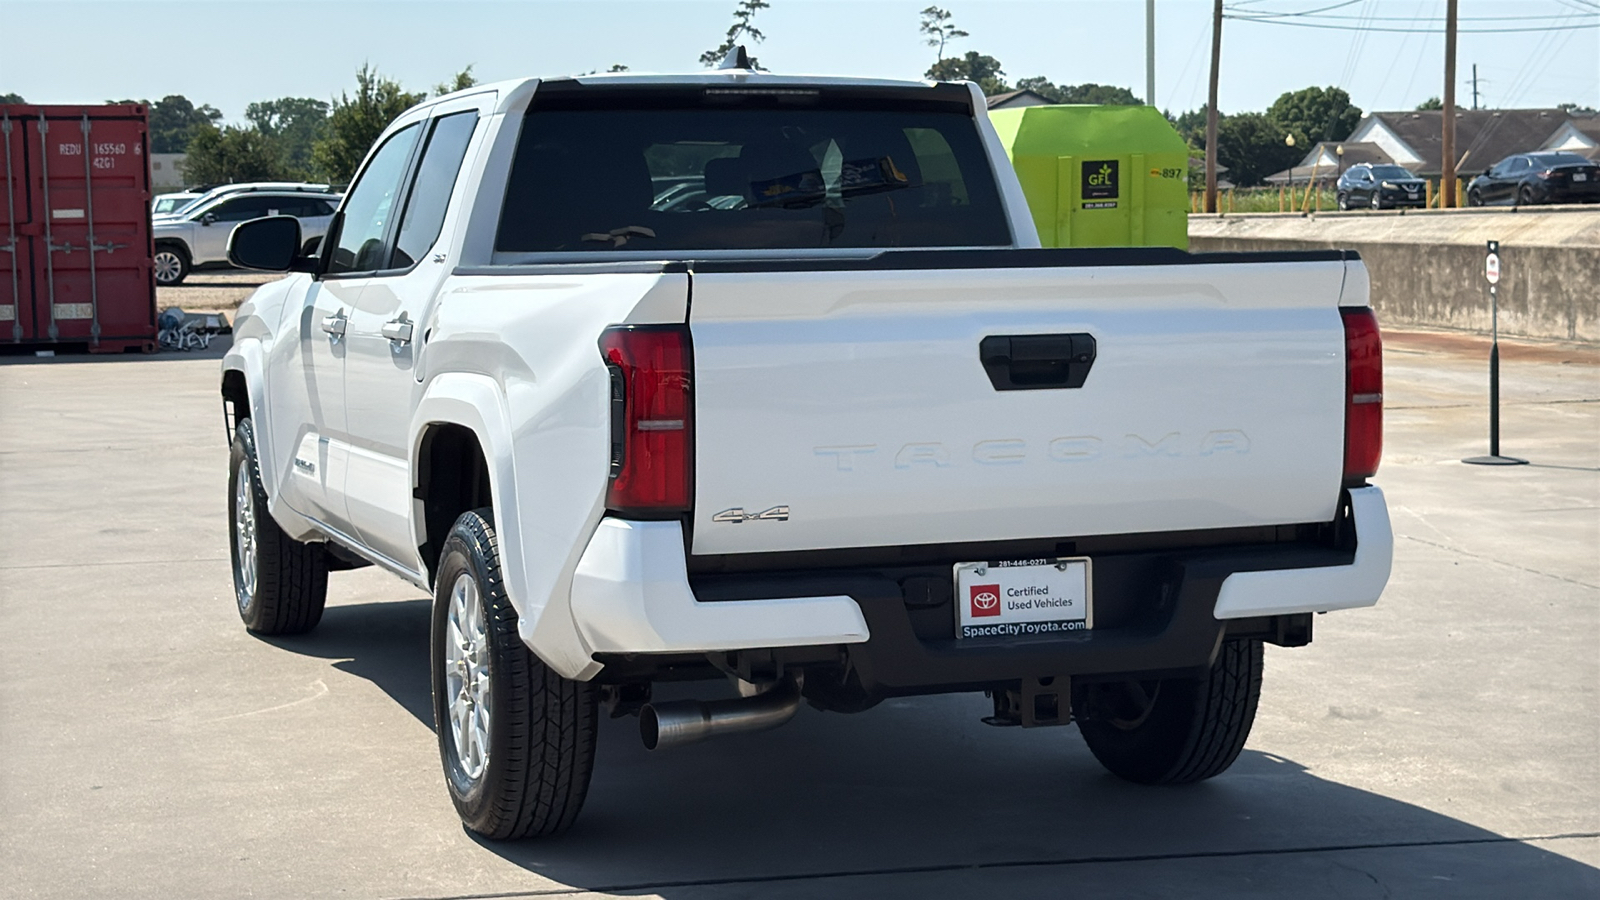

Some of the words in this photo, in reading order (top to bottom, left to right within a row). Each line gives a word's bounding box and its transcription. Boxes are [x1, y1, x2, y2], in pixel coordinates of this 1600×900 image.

[59, 143, 82, 155] REDU
[94, 143, 126, 155] 165560
[134, 143, 141, 155] 6
[93, 157, 115, 169] 42G1
[1088, 168, 1112, 186] GFL
[813, 428, 1252, 472] TACOMA
[998, 559, 1047, 567] 281-446-0271
[1007, 585, 1049, 597] Certified
[1007, 599, 1032, 611] Used
[1034, 596, 1073, 609] Vehicles
[963, 621, 1085, 638] SpaceCityToyota.com
